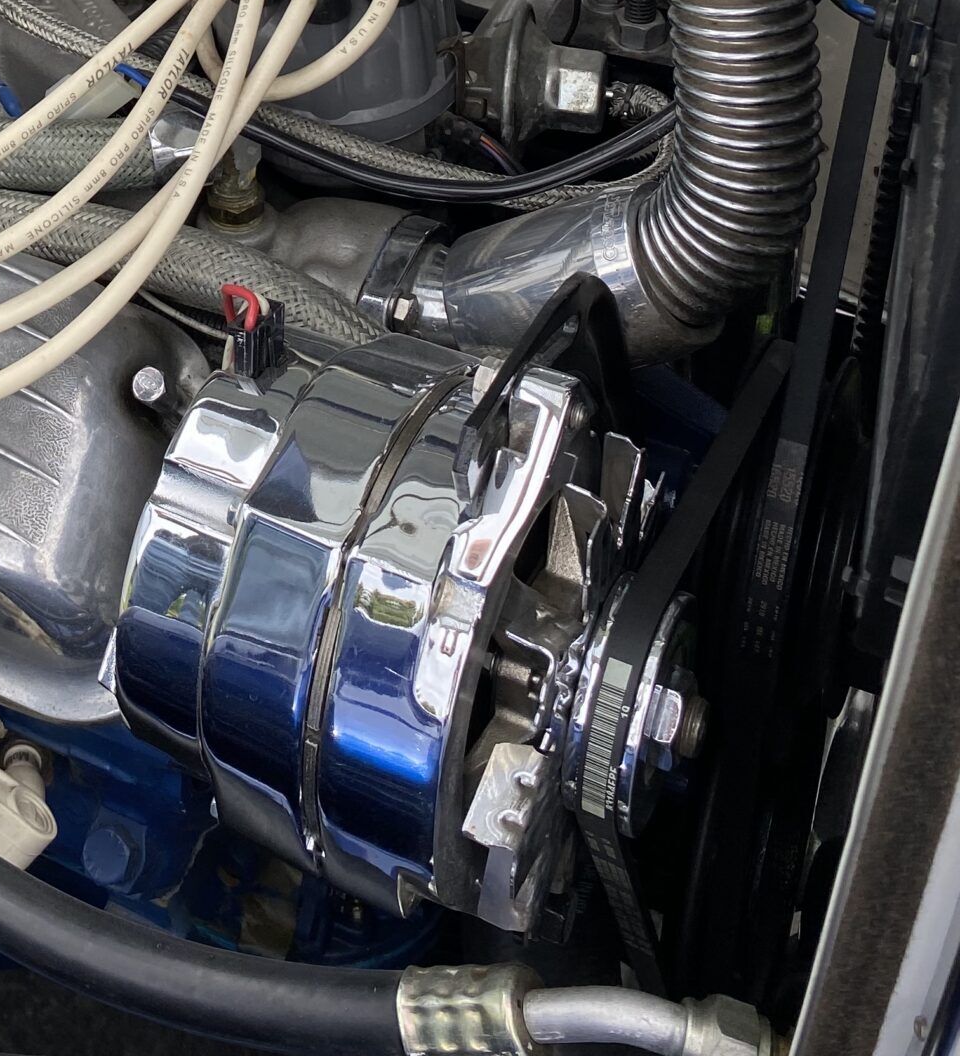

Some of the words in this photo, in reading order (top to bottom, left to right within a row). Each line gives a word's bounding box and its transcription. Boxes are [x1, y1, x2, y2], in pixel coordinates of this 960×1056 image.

[367, 12, 379, 24] IN
[86, 42, 134, 88] TAYLOR
[157, 48, 190, 101] TAYLOR
[215, 50, 237, 101] SILICONE
[46, 92, 77, 120] SPIRO
[21, 120, 42, 140] PRO
[131, 107, 155, 140] SPIRO
[198, 112, 216, 144] MADE
[110, 143, 130, 166] PRO
[190, 150, 201, 163] IN
[83, 169, 108, 192] 8mm
[25, 195, 81, 240] SILICONE
